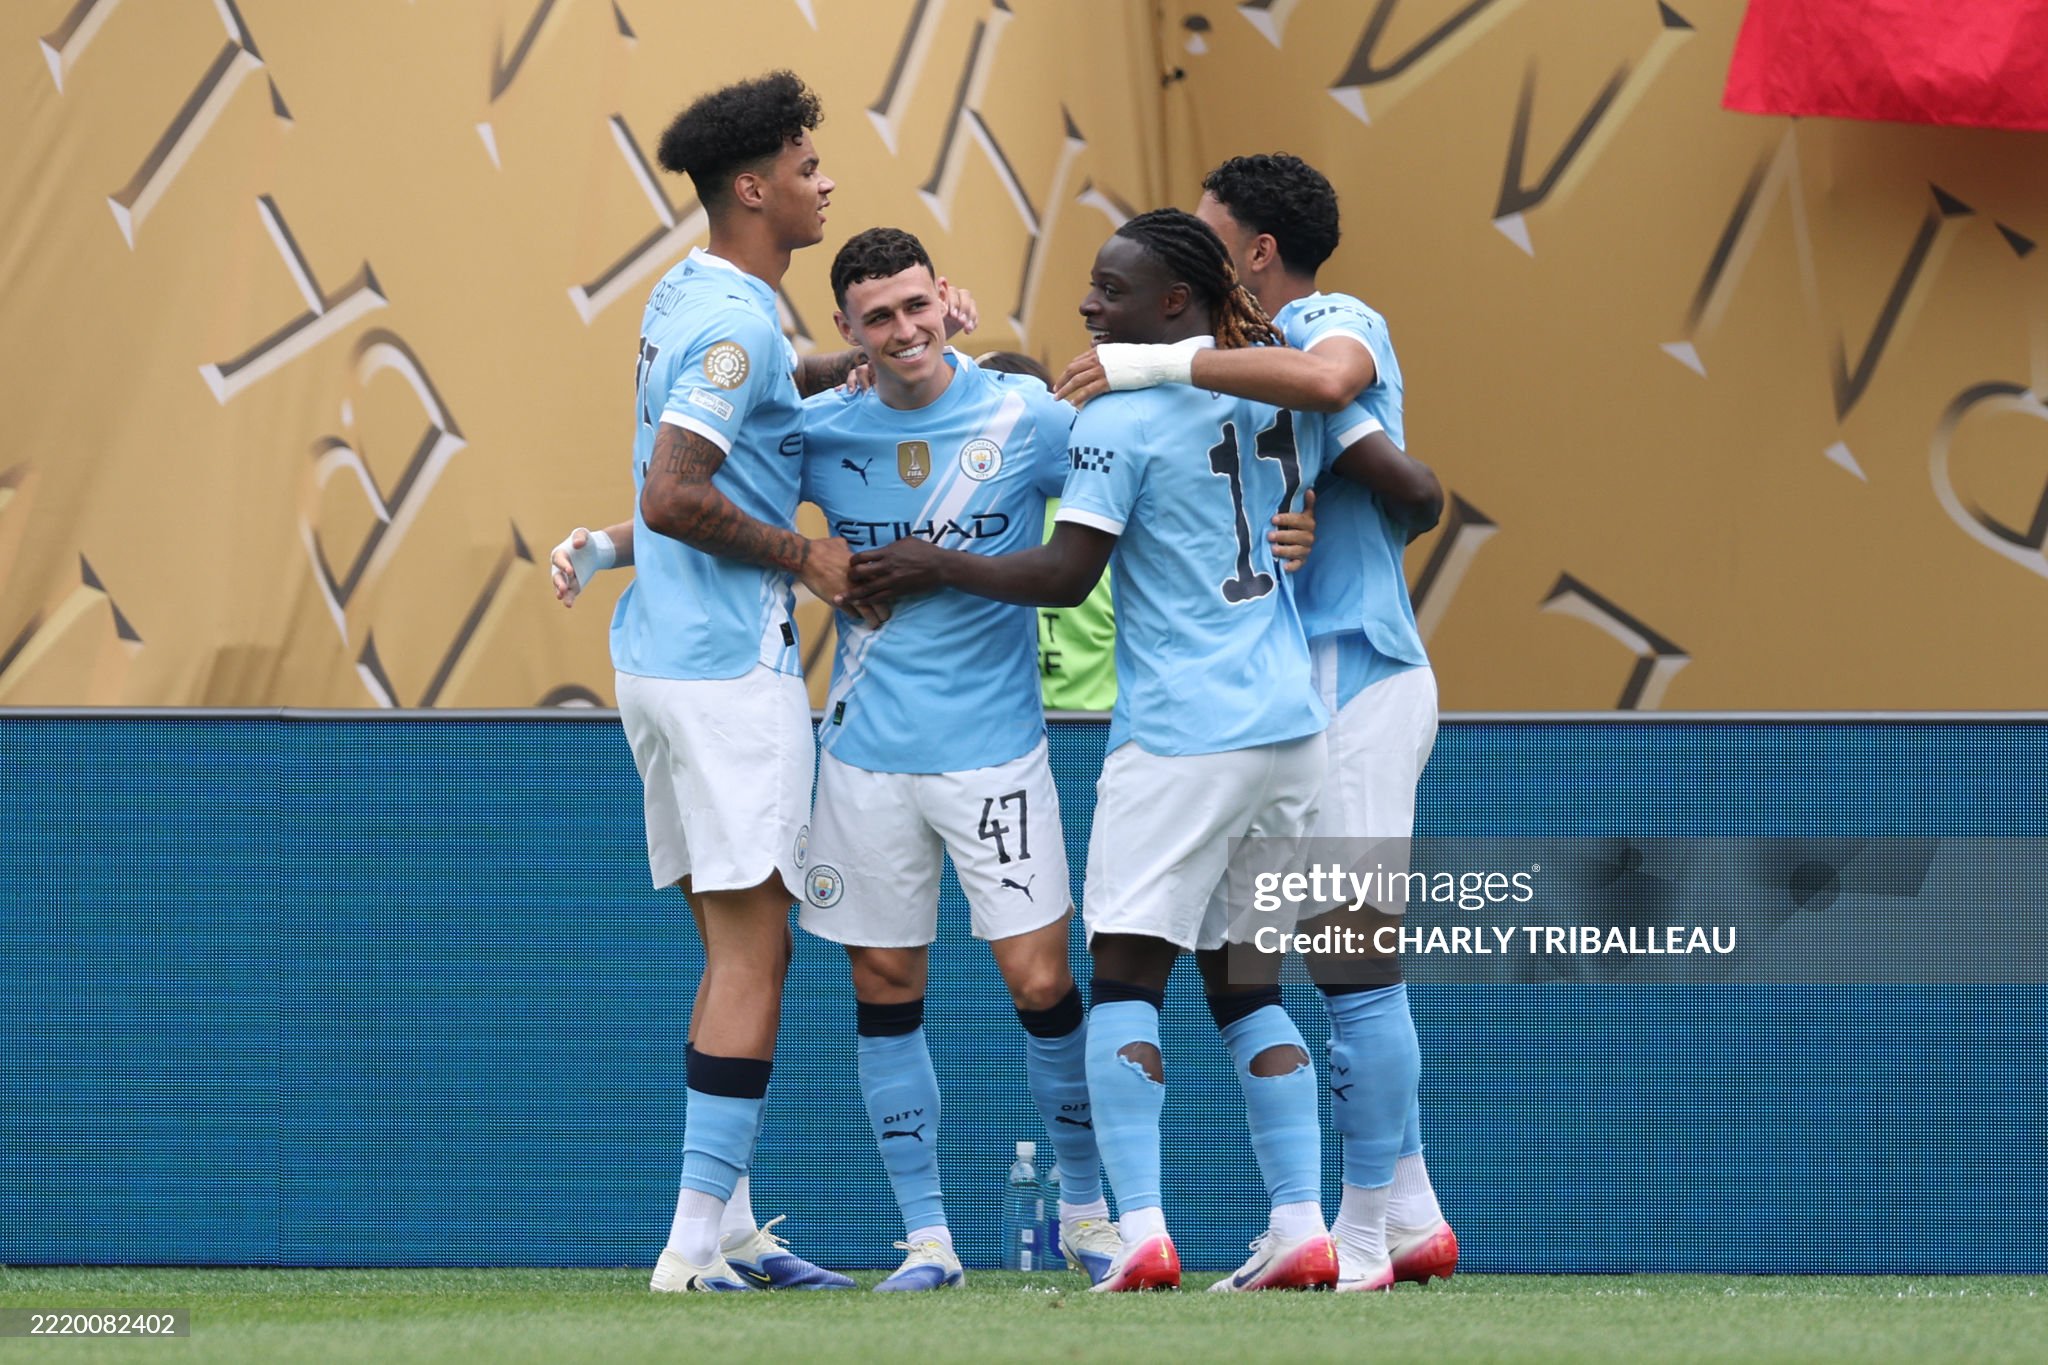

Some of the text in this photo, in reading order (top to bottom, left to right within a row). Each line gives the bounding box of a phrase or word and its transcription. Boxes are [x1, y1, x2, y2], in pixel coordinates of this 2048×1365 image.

[712, 345, 735, 356] WORLD
[712, 374, 730, 388] FIFA
[1207, 407, 1301, 604] 11
[835, 512, 1009, 547] ETIHAD
[978, 789, 1031, 864] 47
